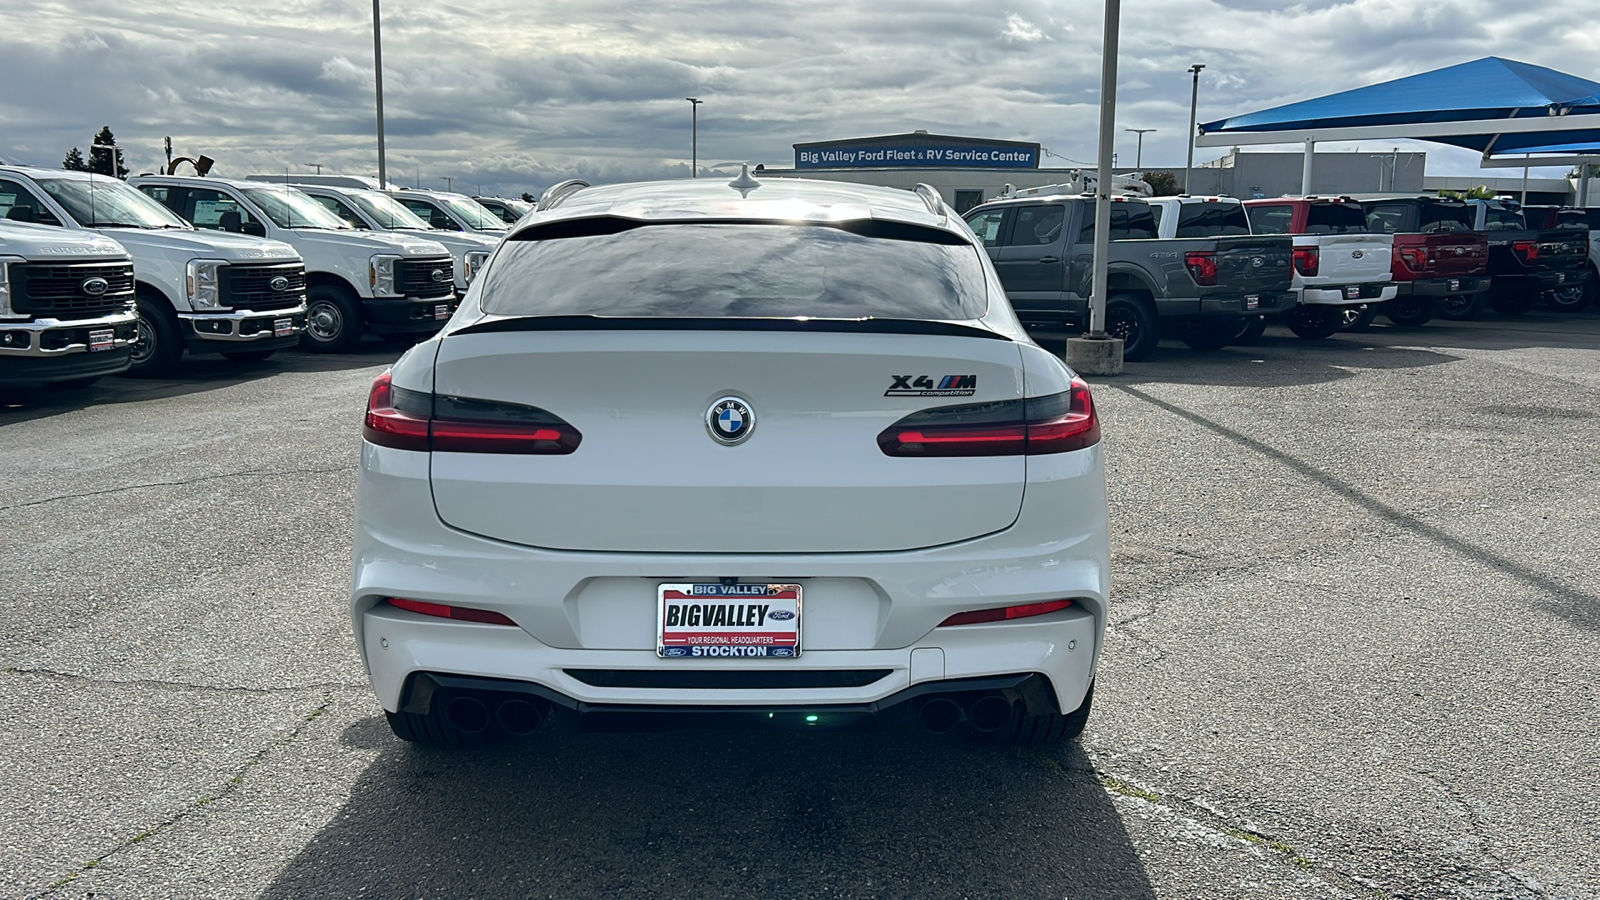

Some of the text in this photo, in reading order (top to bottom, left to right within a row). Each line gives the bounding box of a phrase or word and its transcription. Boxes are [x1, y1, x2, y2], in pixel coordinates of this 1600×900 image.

[800, 149, 1031, 163] Big Valley Ford Fleet & RV Service Center
[889, 375, 934, 389] X4
[694, 586, 766, 594] BIG VALLEY
[687, 636, 774, 644] YOUR REGIONAL HEADQUARTERS
[692, 646, 767, 657] STOCKTON
